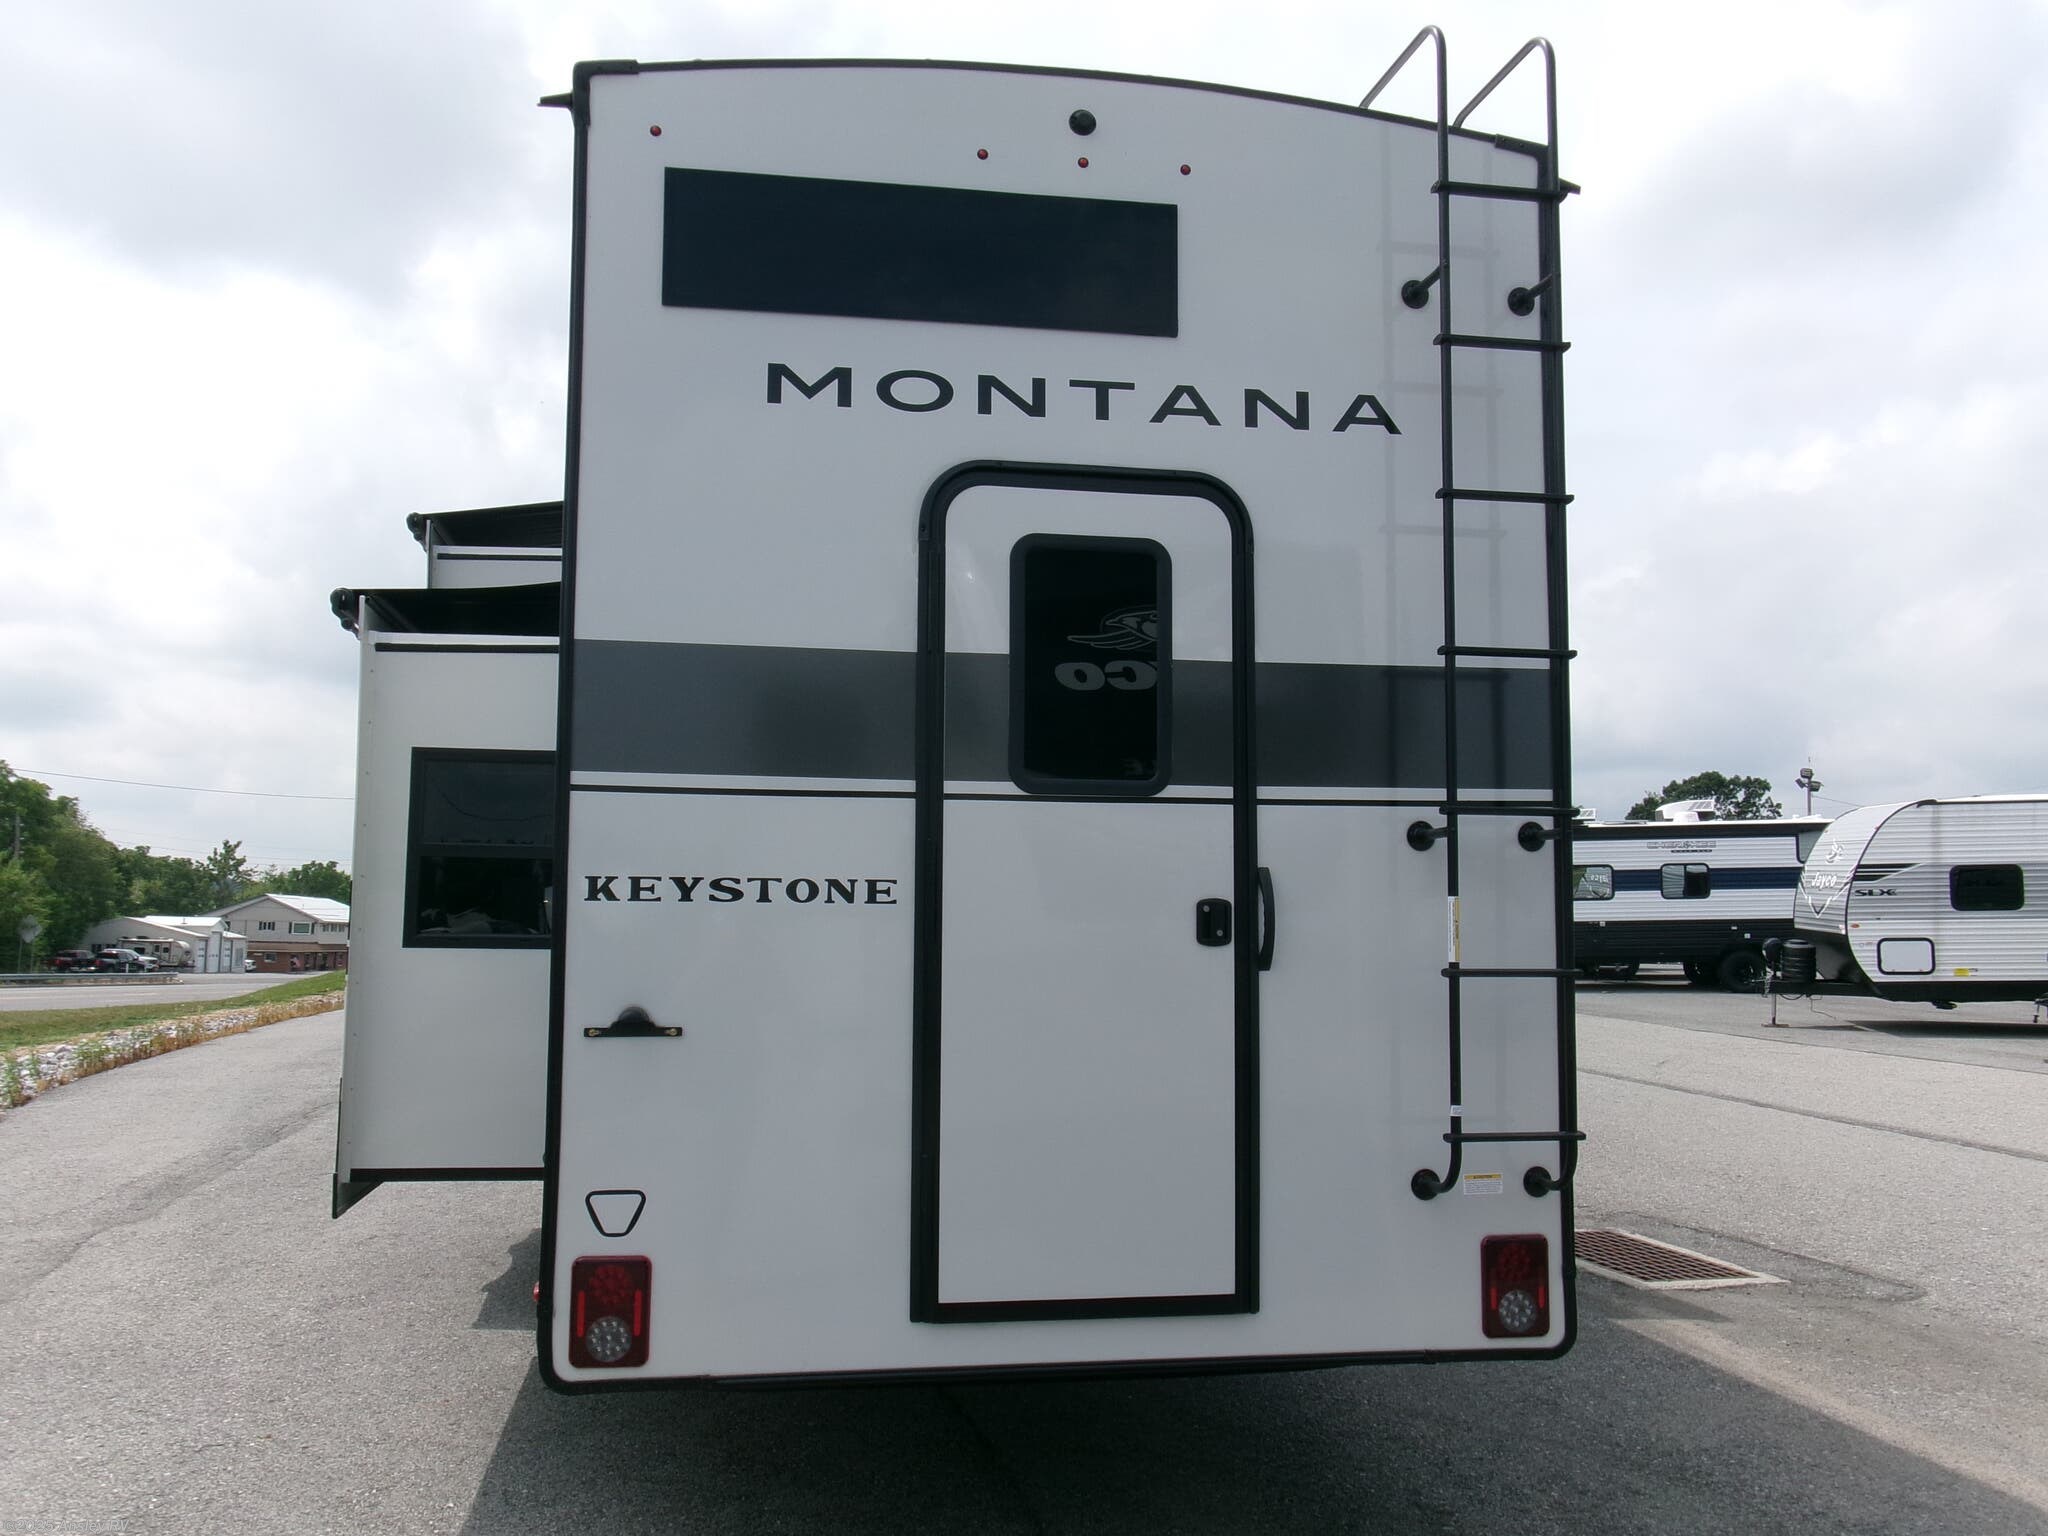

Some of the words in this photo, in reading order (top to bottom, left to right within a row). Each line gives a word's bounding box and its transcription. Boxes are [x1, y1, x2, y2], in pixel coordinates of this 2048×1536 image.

[767, 362, 1402, 435] MONTANA
[584, 875, 898, 905] KEYSTONE
[1811, 871, 1838, 889] Jayco
[1854, 888, 1897, 897] SLX
